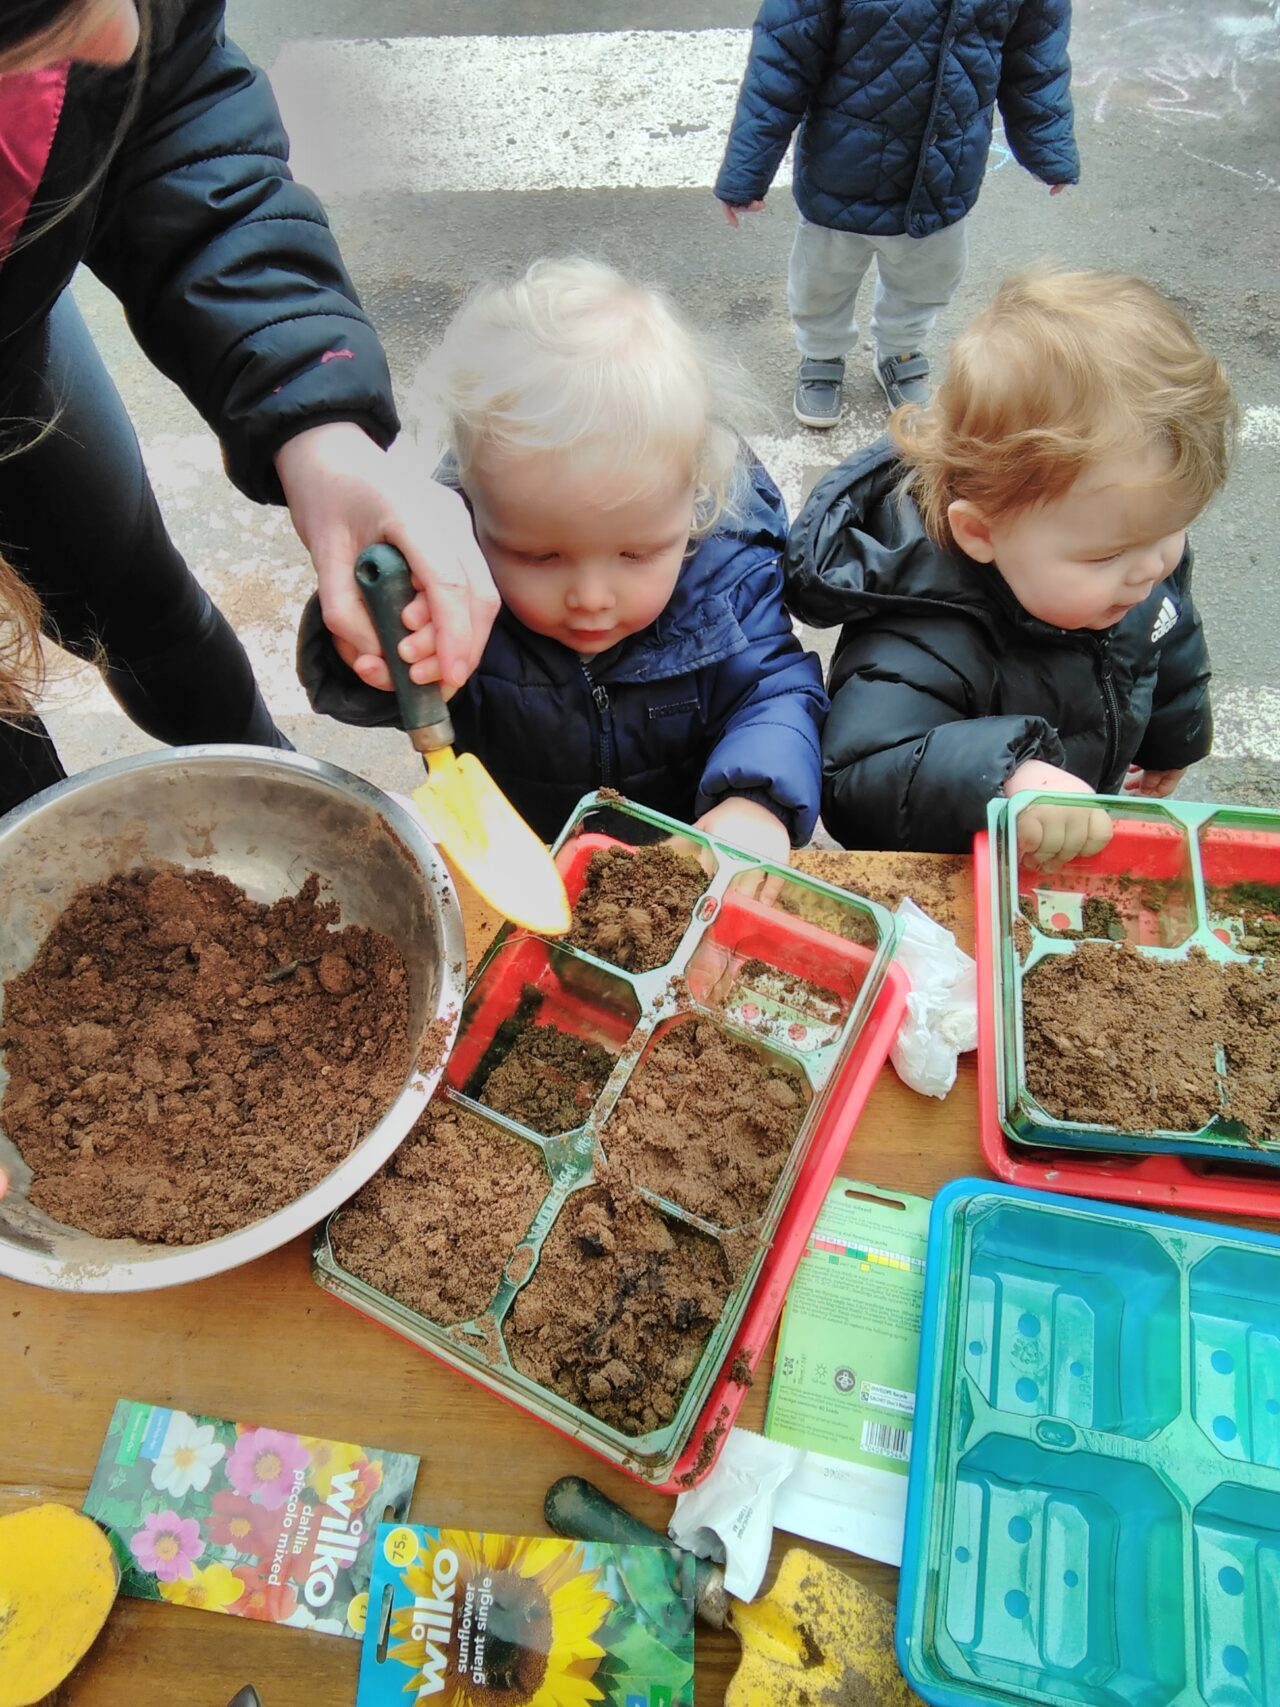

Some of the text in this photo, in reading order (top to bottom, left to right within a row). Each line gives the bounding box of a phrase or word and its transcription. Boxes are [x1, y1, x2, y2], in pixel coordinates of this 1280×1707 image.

[268, 1470, 306, 1586] piccolo mixed
[293, 1505, 314, 1554] dahlia
[304, 1469, 363, 1607] wilko
[392, 1534, 408, 1560] 75p
[411, 1548, 459, 1697] wilko
[457, 1583, 475, 1673] sunflower
[470, 1577, 494, 1685] giant single
